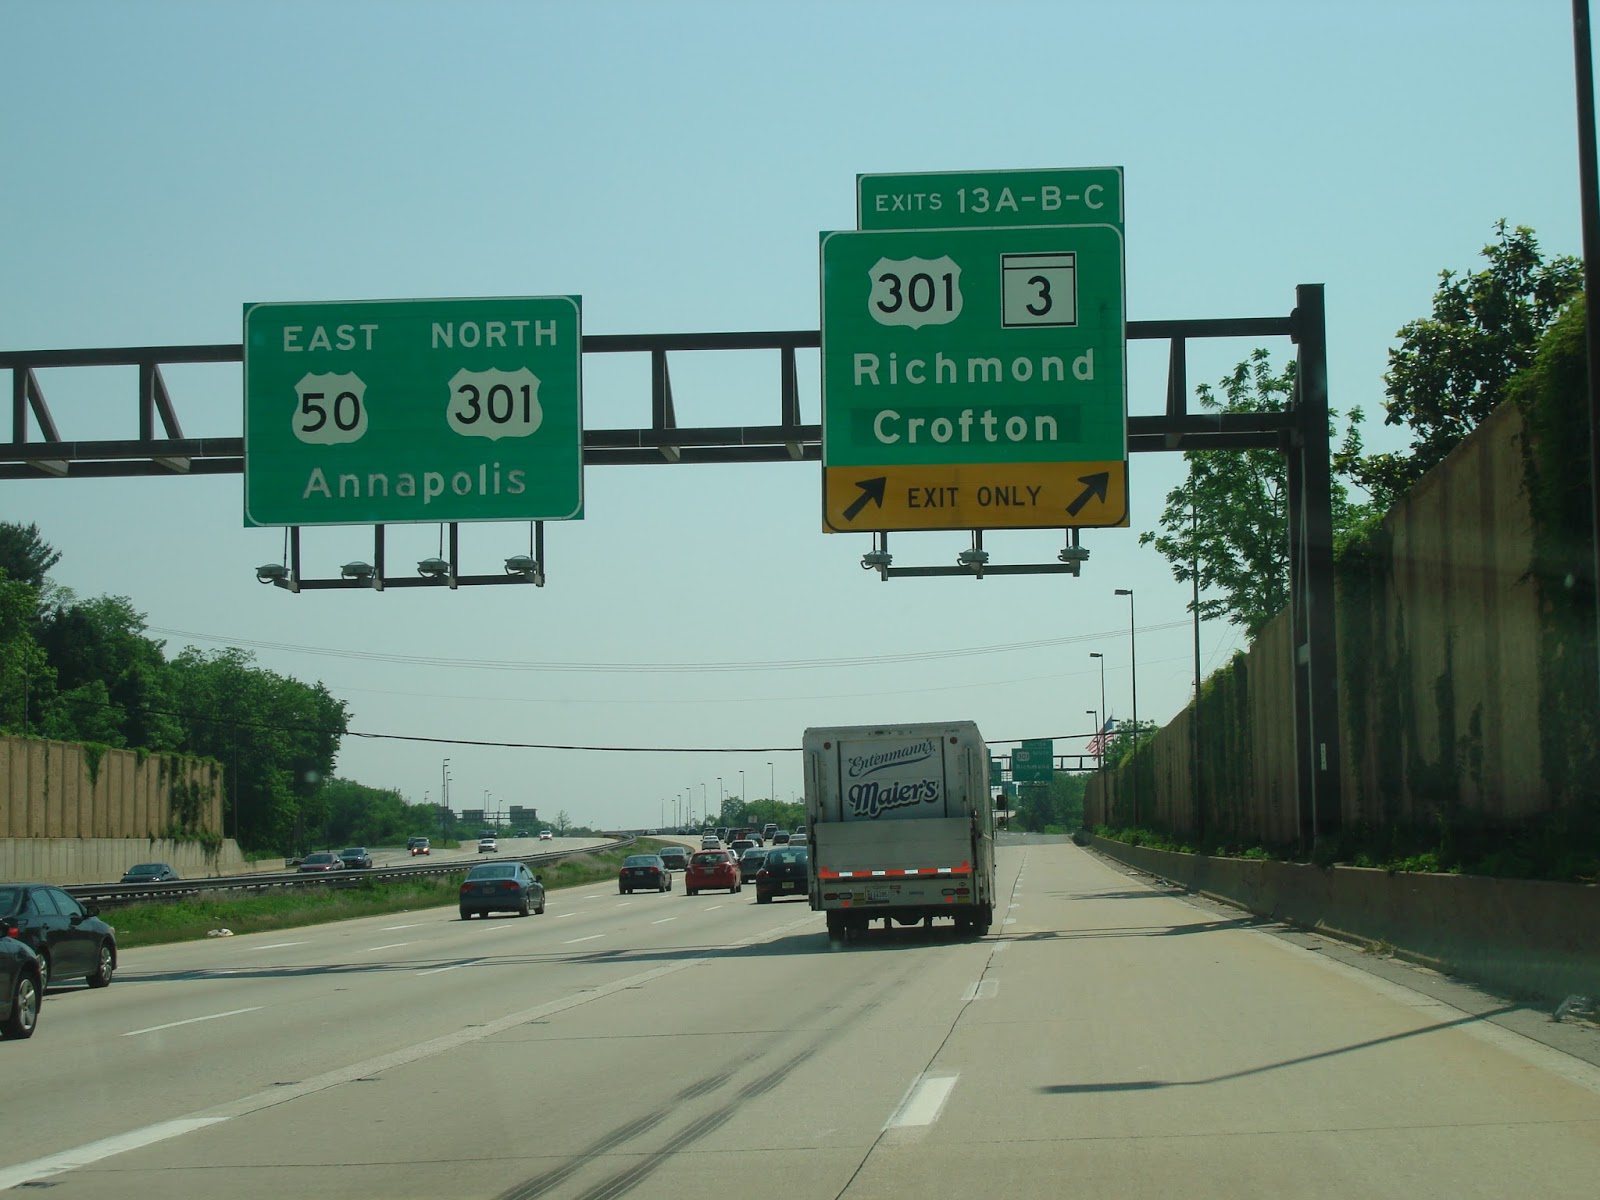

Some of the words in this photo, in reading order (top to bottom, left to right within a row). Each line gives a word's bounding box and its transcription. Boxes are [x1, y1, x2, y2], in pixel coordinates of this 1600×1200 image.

[875, 193, 943, 212] EXITS
[956, 184, 1105, 213] 13A-B-C
[876, 272, 953, 314] 301
[1025, 275, 1053, 316] 3
[283, 324, 379, 352] EAST
[432, 319, 557, 349] NORTH
[853, 348, 1095, 386] Richmond
[301, 391, 361, 433] 50
[454, 384, 531, 425] 301
[873, 408, 1058, 444] Crofton
[302, 462, 526, 505] Annapolis
[907, 487, 959, 509] EXIT
[976, 485, 1042, 507] ONLY
[848, 780, 939, 817] Maier's
